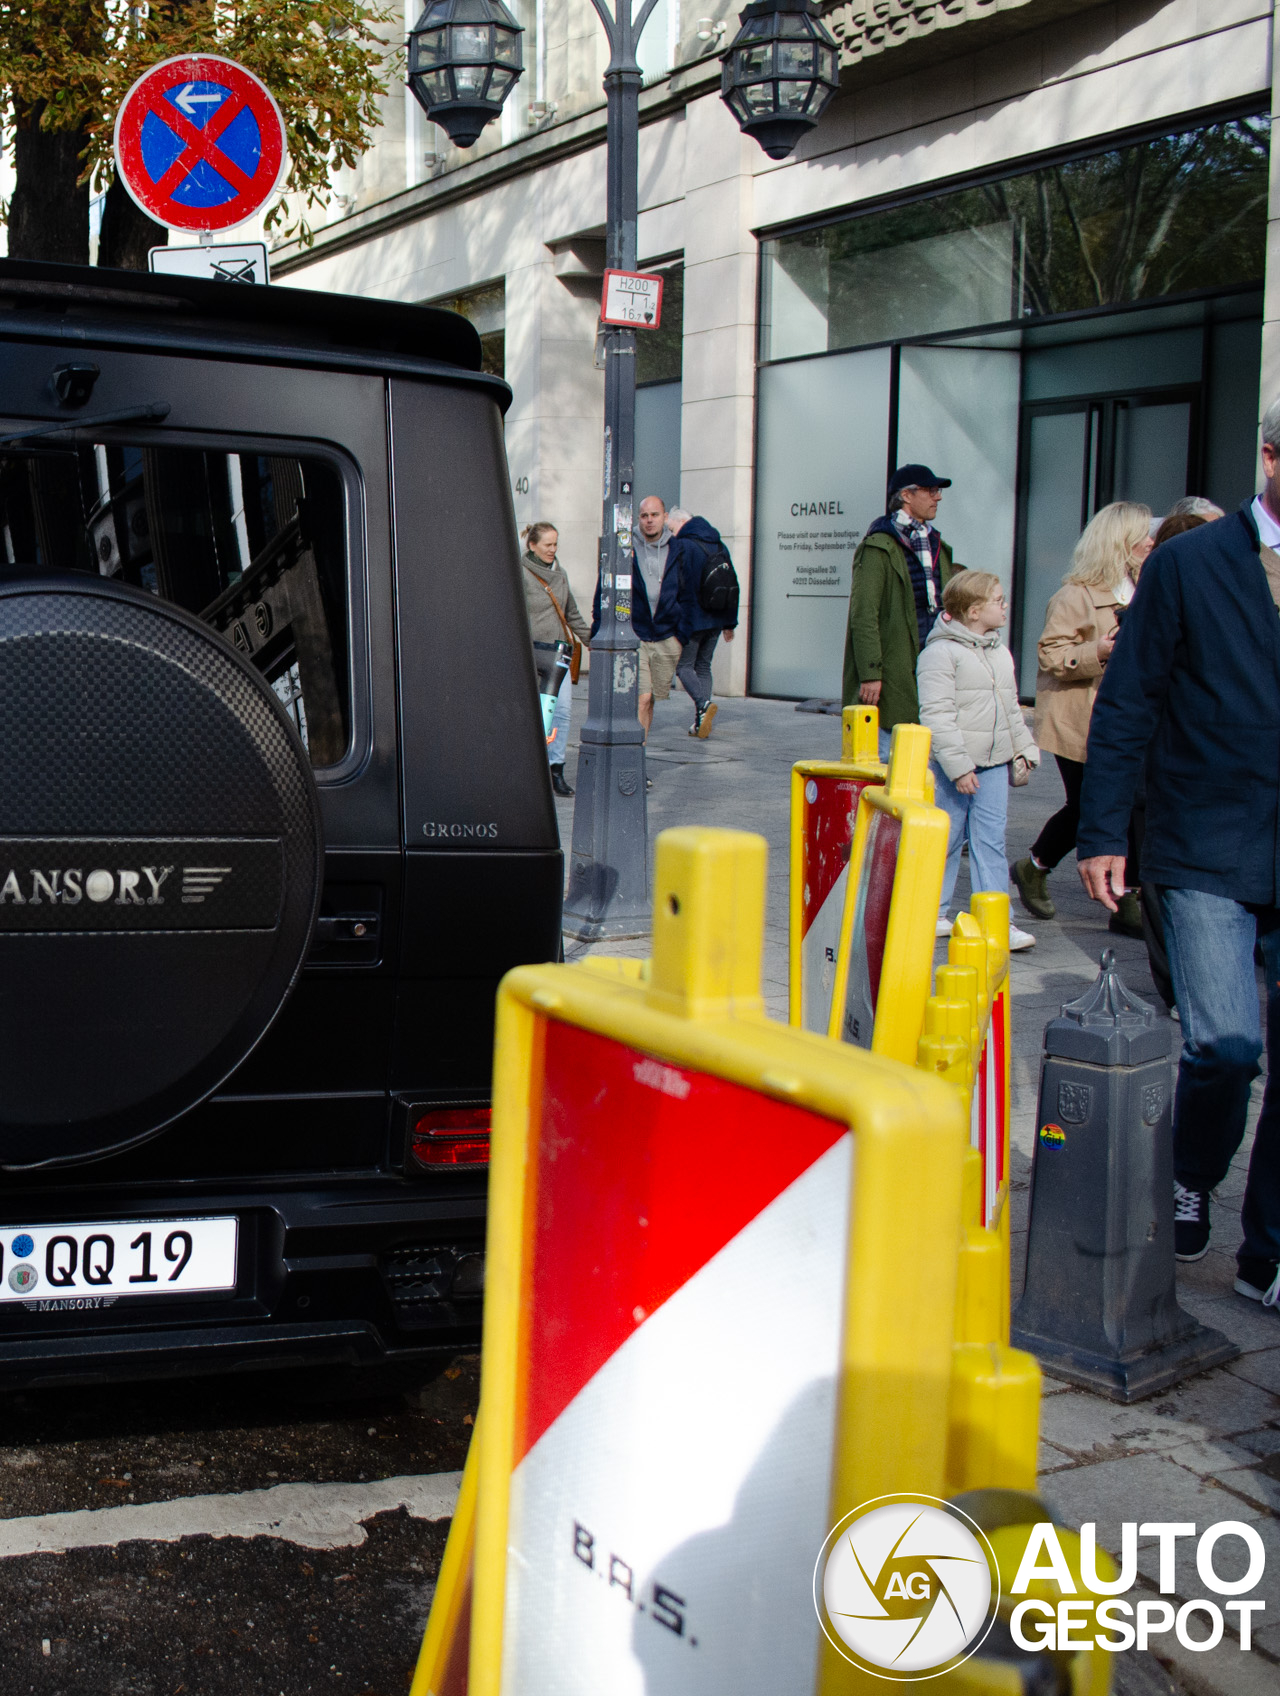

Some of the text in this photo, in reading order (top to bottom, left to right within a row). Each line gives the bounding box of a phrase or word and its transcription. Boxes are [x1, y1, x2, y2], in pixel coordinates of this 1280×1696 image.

[620, 277, 649, 292] H200
[515, 476, 529, 495] 40
[790, 501, 844, 516] CHANEL
[777, 531, 796, 539] Please
[796, 531, 809, 539] visit
[833, 530, 860, 539] boutique
[779, 542, 793, 551] from
[814, 542, 846, 552] September
[796, 565, 828, 575] Königsallee
[808, 576, 841, 585] Düsseldorf
[422, 822, 498, 838] GRONOS
[45, 1233, 114, 1288] QQ
[128, 1230, 194, 1284] 19
[38, 1297, 103, 1312] MANSORY
[573, 1519, 699, 1648] B.A.S.
